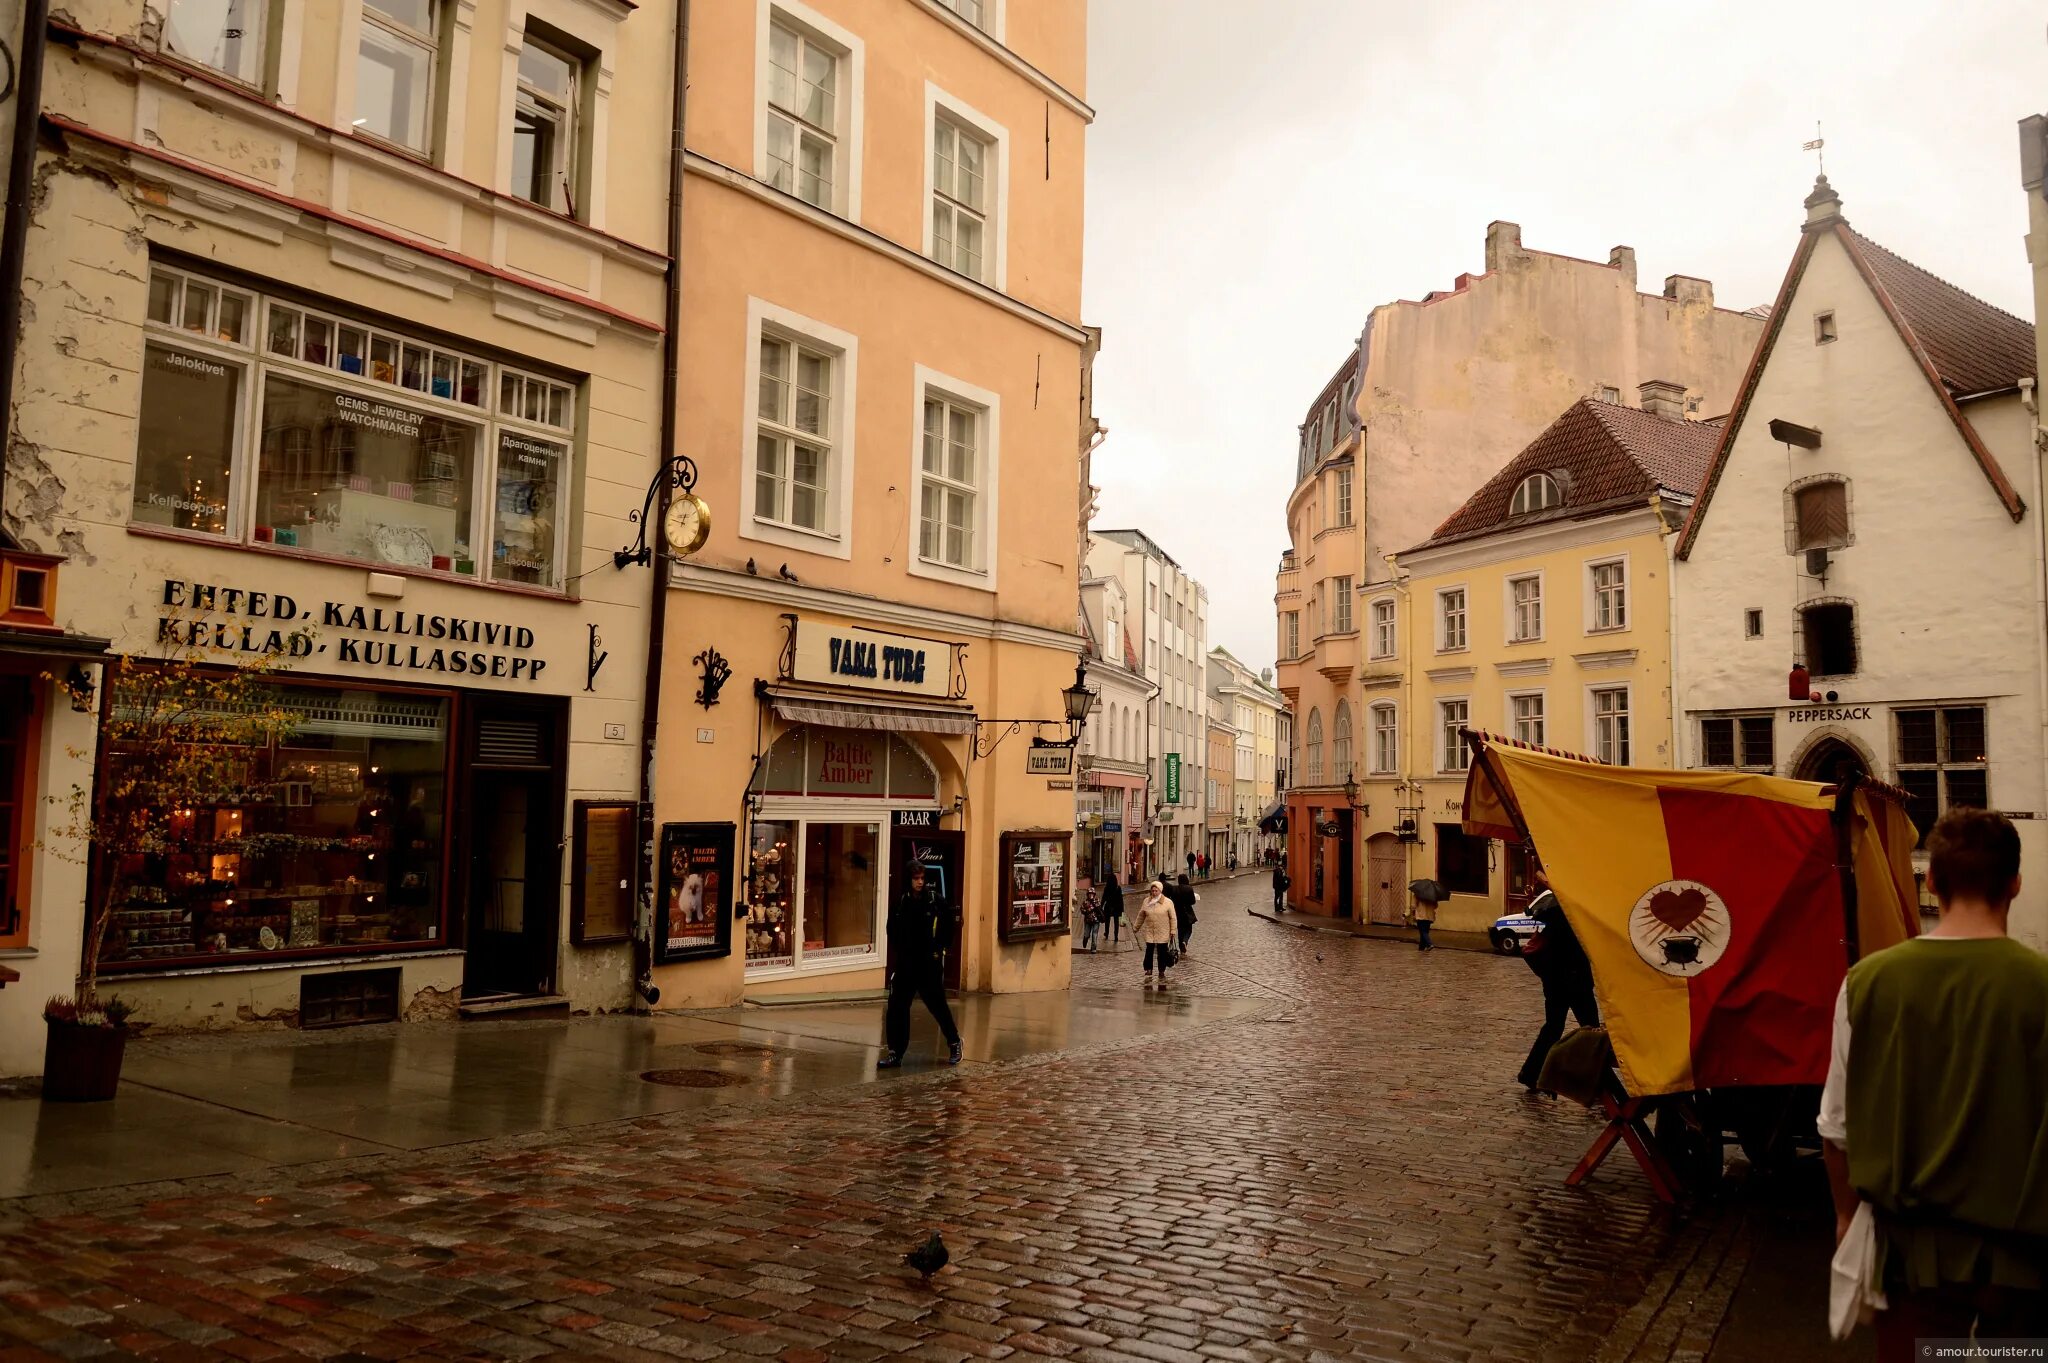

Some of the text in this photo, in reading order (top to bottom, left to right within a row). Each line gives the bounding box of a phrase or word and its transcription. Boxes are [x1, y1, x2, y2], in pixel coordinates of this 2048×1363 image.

[167, 353, 225, 376] Jalokivet
[335, 396, 423, 425] GEMS JEWELRY
[339, 410, 419, 438] WATCHMAKER
[518, 454, 547, 467] камни
[323, 602, 534, 649] KALLISKIVID
[338, 638, 547, 680] KULLASSEPP
[830, 638, 925, 683] VANA TURG
[1789, 708, 1872, 722] PEPPERSACK
[612, 727, 619, 736] 5
[703, 731, 709, 740] 7
[824, 741, 873, 765] Baltic
[1032, 757, 1048, 769] VANA
[819, 760, 873, 783] Amber
[1169, 758, 1177, 799] SALAMANDER
[900, 811, 931, 825] BAAR
[917, 846, 944, 861] Baar
